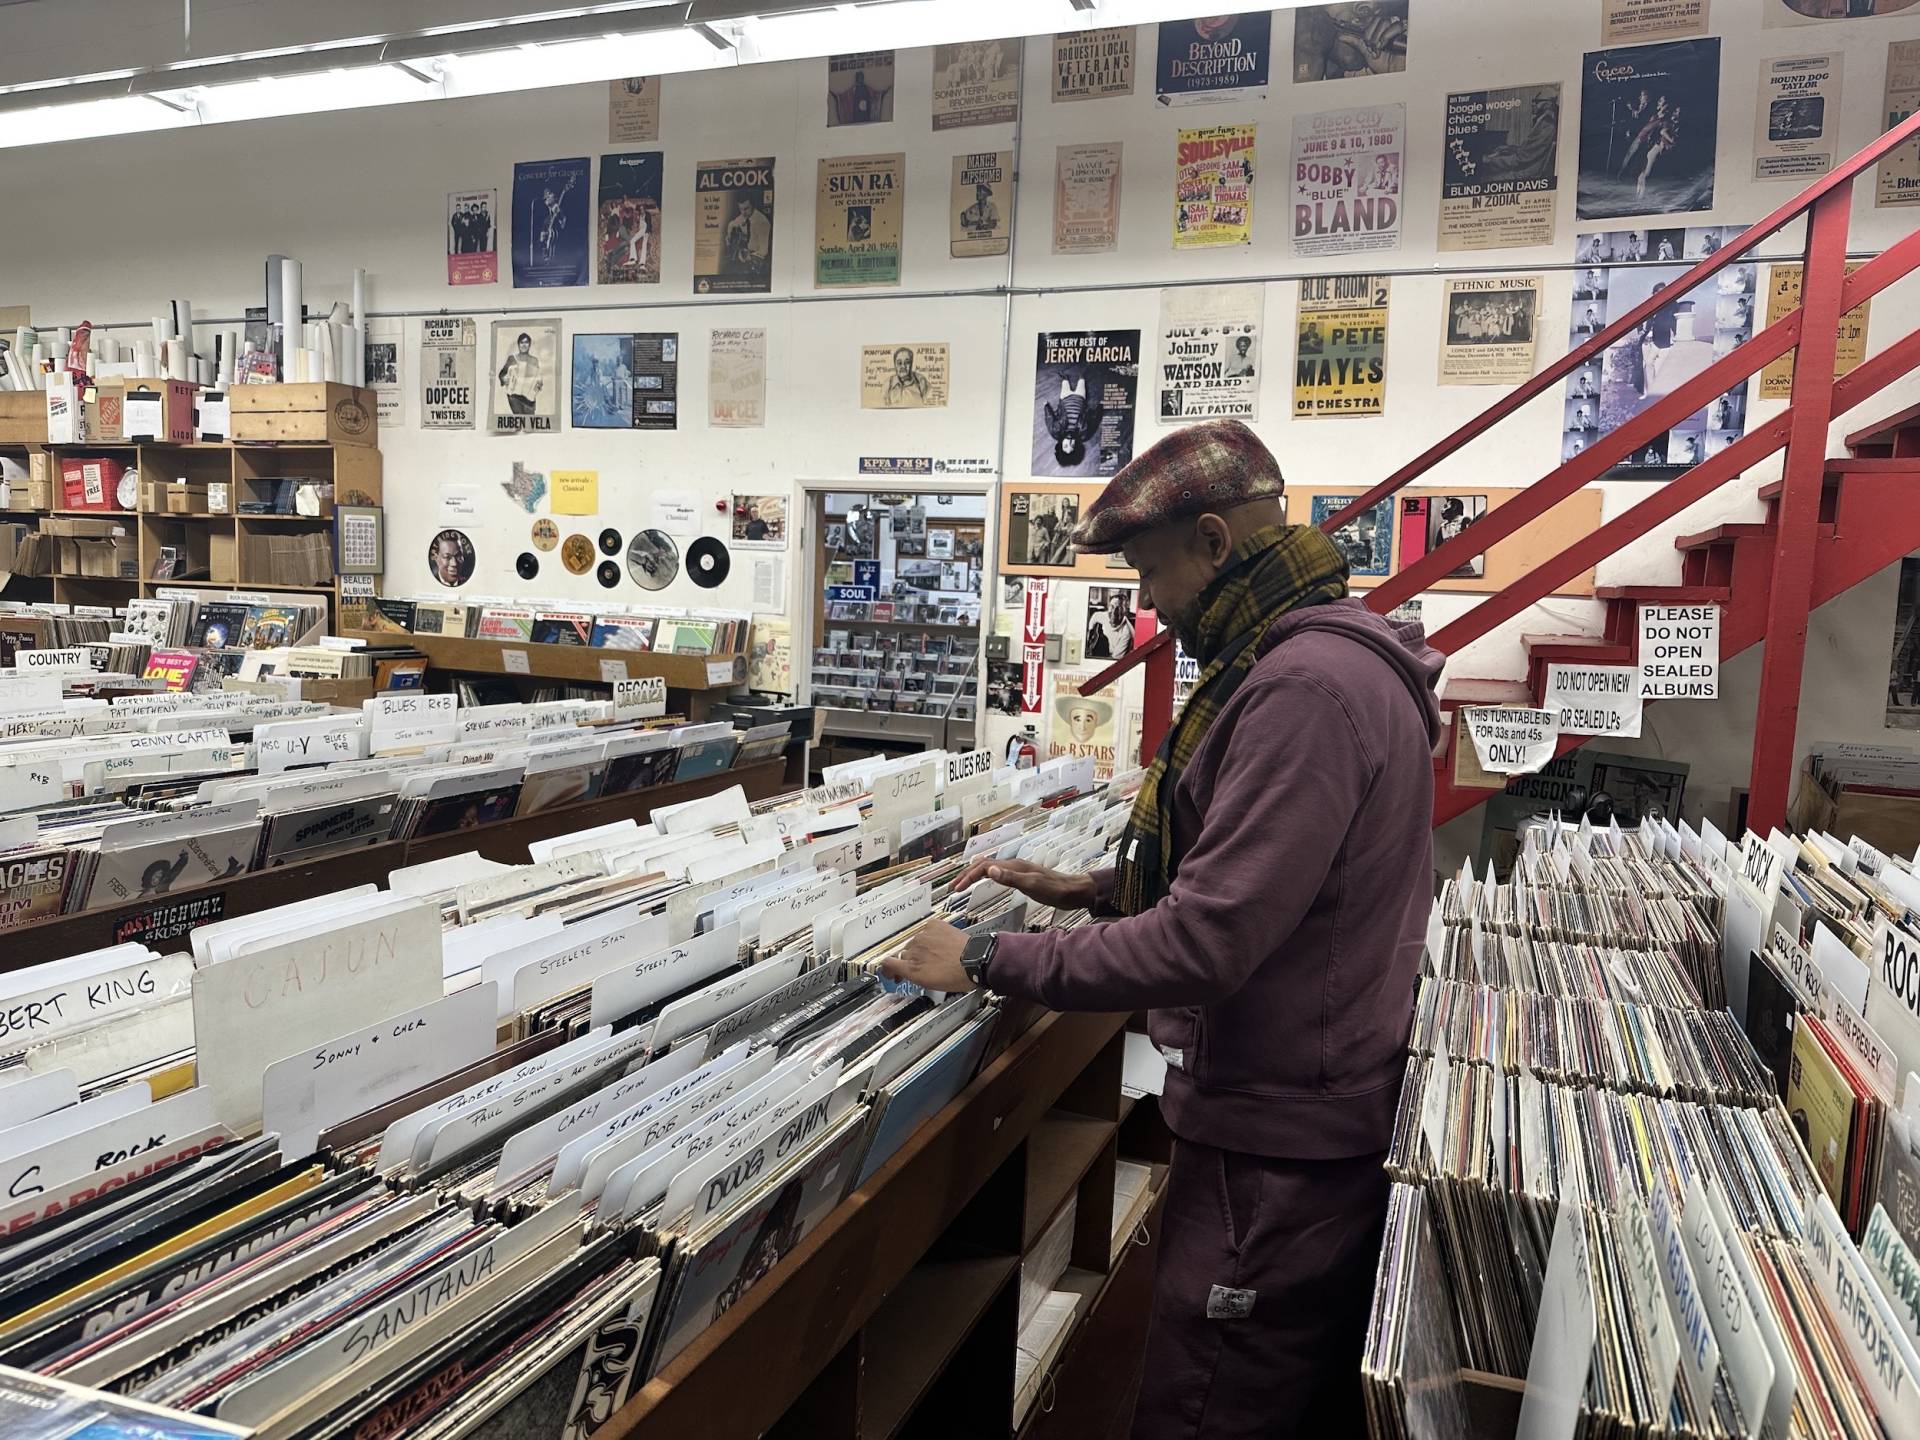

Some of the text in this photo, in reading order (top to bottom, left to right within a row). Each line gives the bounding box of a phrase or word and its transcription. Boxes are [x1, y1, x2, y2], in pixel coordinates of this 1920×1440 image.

[1638, 9, 1700, 22] COMMUNITY THEATRE
[1058, 41, 1129, 61] ORQUESTA LOCAL
[1189, 38, 1242, 60] BEYOND
[1058, 56, 1130, 75] VETERANS
[1171, 52, 1256, 78] DESCRIPTION
[1062, 72, 1126, 89] MEMORIAL
[1187, 74, 1239, 88] (1973-1989)
[1770, 72, 1829, 84] HOUND DOG
[1781, 81, 1818, 90] TAYLOR
[935, 85, 989, 100] SONNY TERRY
[949, 95, 985, 108] BROWNIE
[1449, 97, 1522, 115] boogie woogie
[1448, 113, 1492, 125] chicago
[1447, 125, 1479, 136] blues
[1177, 136, 1255, 166] SOULSVILLE
[1303, 140, 1329, 153] JUNE
[1330, 139, 1338, 150] 9
[1339, 138, 1347, 149] &
[1368, 134, 1393, 147] 1980
[967, 152, 997, 169] MANCE
[699, 169, 770, 188] AL COOK
[829, 173, 894, 193] SUN RA
[961, 168, 1002, 185] LIPSCOMB
[1296, 162, 1356, 188] BOBBY
[1306, 187, 1350, 201] "BLUE"
[1450, 178, 1549, 197] BLIND JOHN DAVIS
[846, 198, 886, 206] CONCERT
[1214, 191, 1248, 203] THOMAS
[1472, 193, 1521, 209] IN ZODIAC
[1294, 197, 1398, 237] BLAND
[819, 243, 866, 255] Sunday, April
[1301, 276, 1369, 301] BLUE ROOM
[1453, 278, 1536, 290] ETHNIC MUSIC
[1374, 288, 1388, 306] 2
[424, 319, 460, 329] RICHARD'S
[430, 329, 454, 337] CLUB
[1166, 328, 1197, 339] JULY
[1331, 326, 1385, 346] PETE
[1046, 336, 1109, 348] THE VERY BEST OF
[1168, 341, 1219, 356] Johnny
[1044, 346, 1132, 364] JERRY GARCIA
[1163, 362, 1222, 381] WATSON
[1296, 356, 1384, 388] MAYES
[1174, 379, 1242, 389] AND BAND
[425, 387, 470, 405] DOPCEE
[1297, 397, 1380, 410] ORCHESTRA
[430, 410, 466, 420] TWISTERS
[1184, 403, 1252, 415] JAY PAYTON
[497, 415, 551, 429] RUBEN VELA
[863, 458, 930, 468] KPFA FM 94
[343, 576, 372, 585] SEALED
[1029, 581, 1045, 591] FIRE
[342, 587, 374, 595] ALBUMS
[839, 588, 867, 599] SOUL
[1645, 608, 1714, 621] PLEASE
[1645, 626, 1713, 640] DO NOT
[28, 653, 81, 666] COUNTRY
[1025, 650, 1041, 660] FIRE
[1654, 646, 1703, 658] OPEN
[154, 657, 166, 665] THE
[1643, 664, 1713, 678] SEALED
[1556, 671, 1631, 693] DO NOT OPEN NEW
[1641, 683, 1714, 696] ALBUMS
[110, 705, 178, 718] PAT METHENY
[382, 699, 417, 715] BLUES
[103, 721, 127, 731] JAZZ
[495, 719, 527, 728] WONDER
[1471, 711, 1551, 725] THIS TURNTABLE IS
[1560, 709, 1621, 730] OR SEALED LPs
[131, 728, 226, 749] BENNY CARTER
[324, 735, 347, 744] BLUES
[1475, 726, 1542, 741] FOR 33s and 45s
[261, 741, 280, 753] MISC
[1050, 741, 1115, 761] the STARS
[1488, 744, 1526, 764] ONLY!
[105, 758, 134, 772] BLUES
[950, 752, 991, 782] BLUES R&B
[891, 772, 926, 798] JAZZ
[295, 808, 355, 842] SPINNERS
[1744, 839, 1775, 895] ROCK
[864, 914, 877, 929] CAT
[540, 935, 626, 975] STEELEYE SPAN
[244, 928, 398, 1009] CAJUN
[635, 958, 668, 977] STEELY
[87, 970, 155, 1009] KING
[714, 1005, 760, 1046] BRUCE
[760, 964, 837, 1017] SPRINGSTEEN
[313, 1018, 427, 1070] SONNY CHER
[1836, 1003, 1882, 1071] ELVIS PRESLEY
[513, 1060, 547, 1083] SNOW
[466, 1037, 646, 1127] PAUL SIMON ART GARFUNKEL
[558, 1077, 648, 1132] CARLY SIMON
[644, 1115, 679, 1148] BOB
[95, 1134, 166, 1171] ROCK
[704, 1092, 833, 1215] DOUG SAHM
[1695, 1210, 1742, 1333] LOU REED
[343, 1246, 496, 1361] SANTANA
